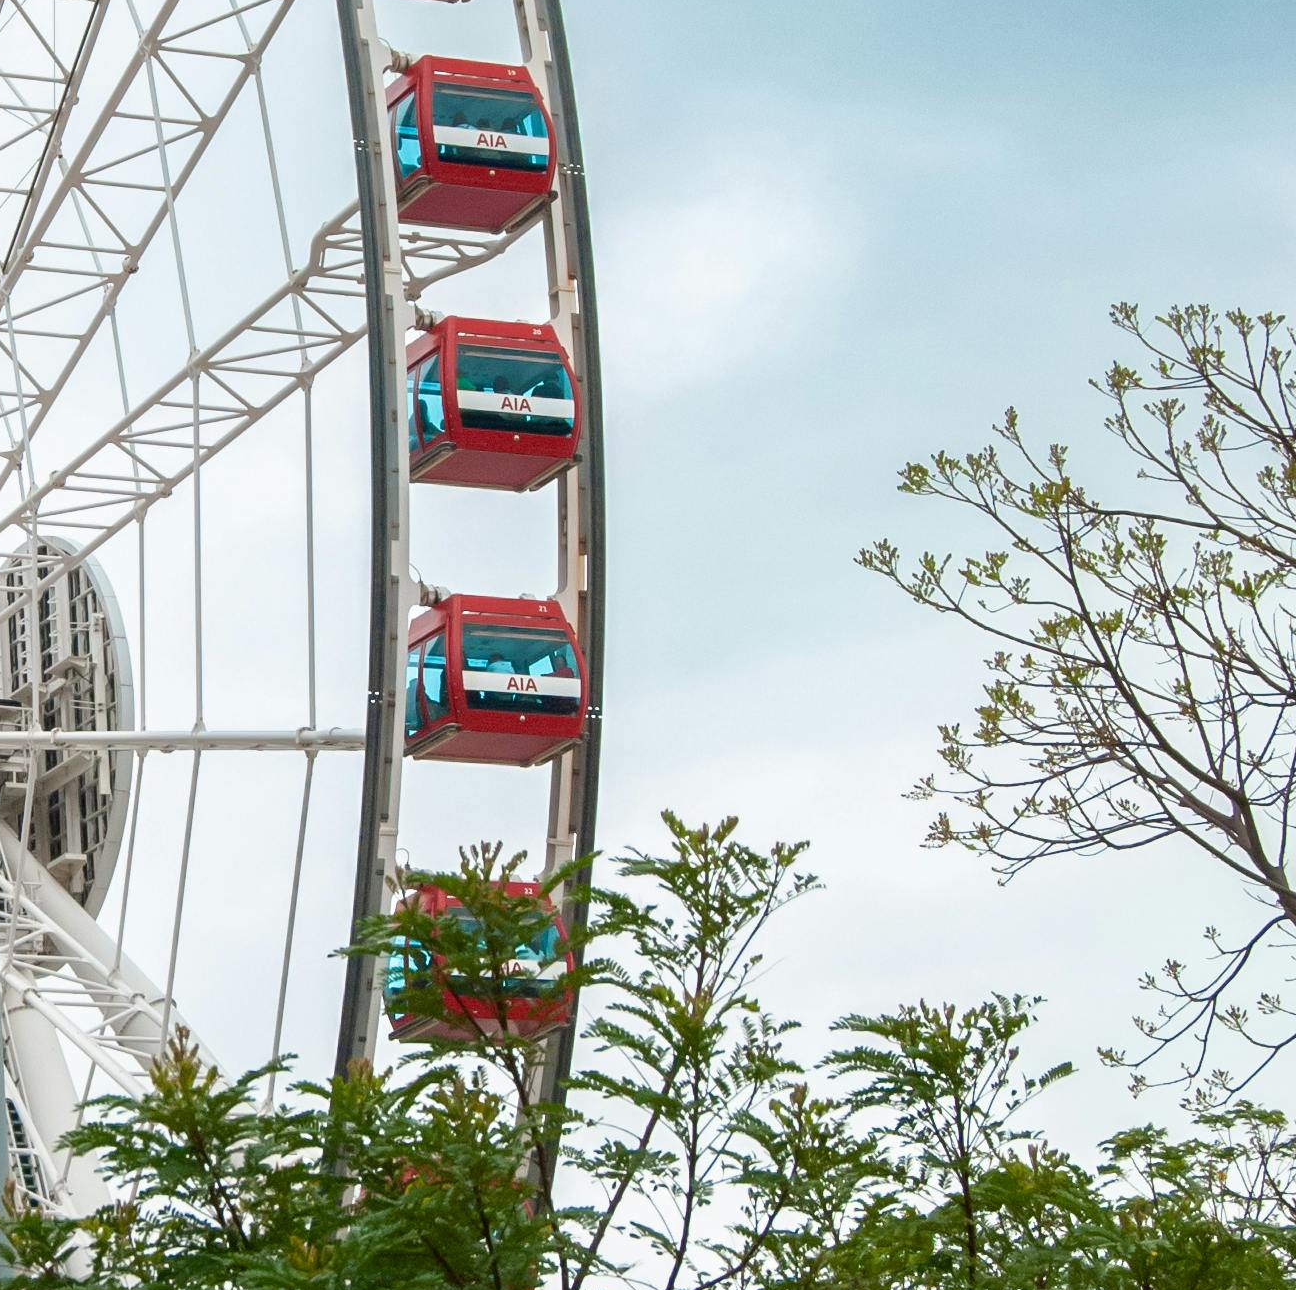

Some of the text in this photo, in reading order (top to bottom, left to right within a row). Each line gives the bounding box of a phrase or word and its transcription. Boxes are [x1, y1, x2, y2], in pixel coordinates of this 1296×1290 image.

[476, 133, 506, 148] AIA
[501, 396, 531, 412] AIA
[507, 676, 537, 692] AIA
[524, 887, 534, 895] 22
